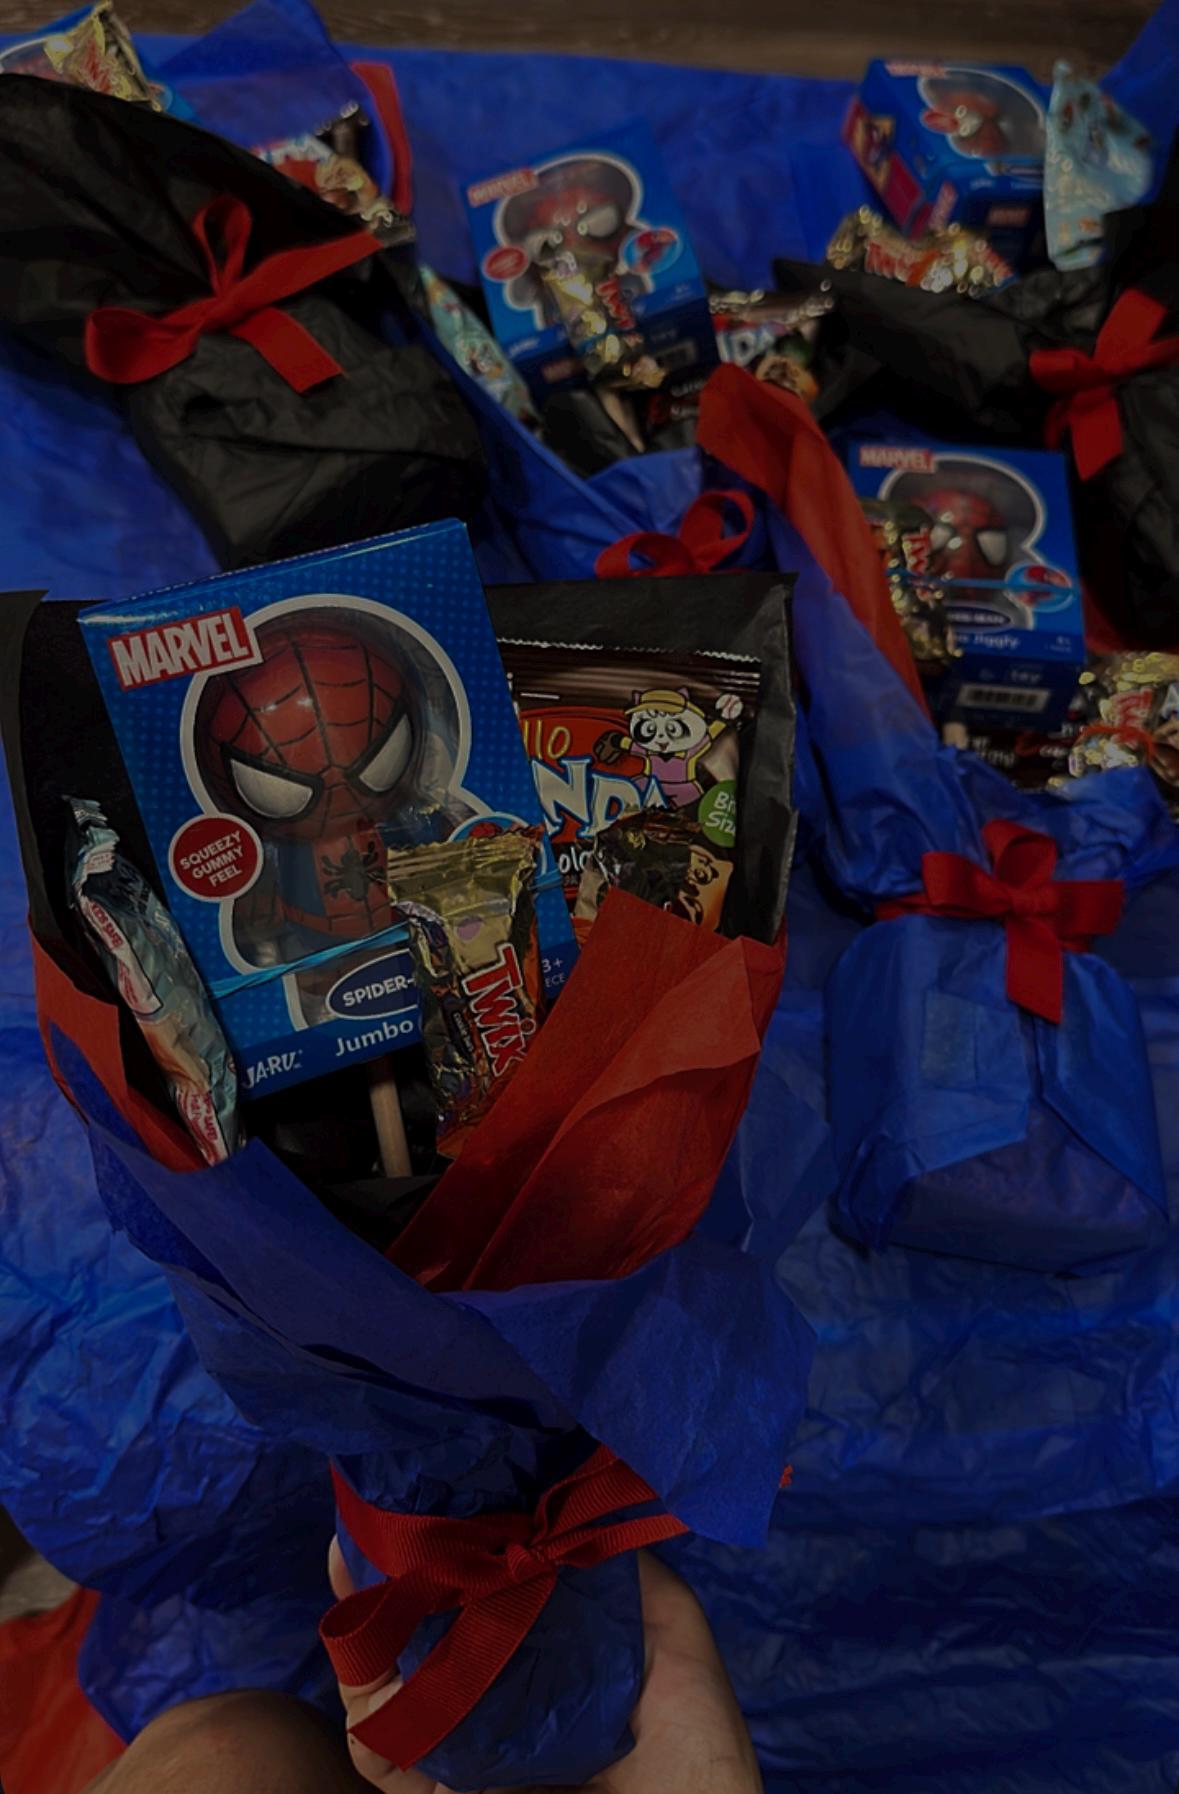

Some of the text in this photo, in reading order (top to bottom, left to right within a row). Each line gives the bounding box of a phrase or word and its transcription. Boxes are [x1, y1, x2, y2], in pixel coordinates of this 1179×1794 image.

[110, 611, 252, 690] MARVEL
[180, 830, 241, 870] SQUEEZY
[192, 845, 243, 879] GUMMY
[209, 864, 243, 887] FEEL
[342, 974, 415, 1008] SPIDER-
[335, 1019, 414, 1057] Jumbo
